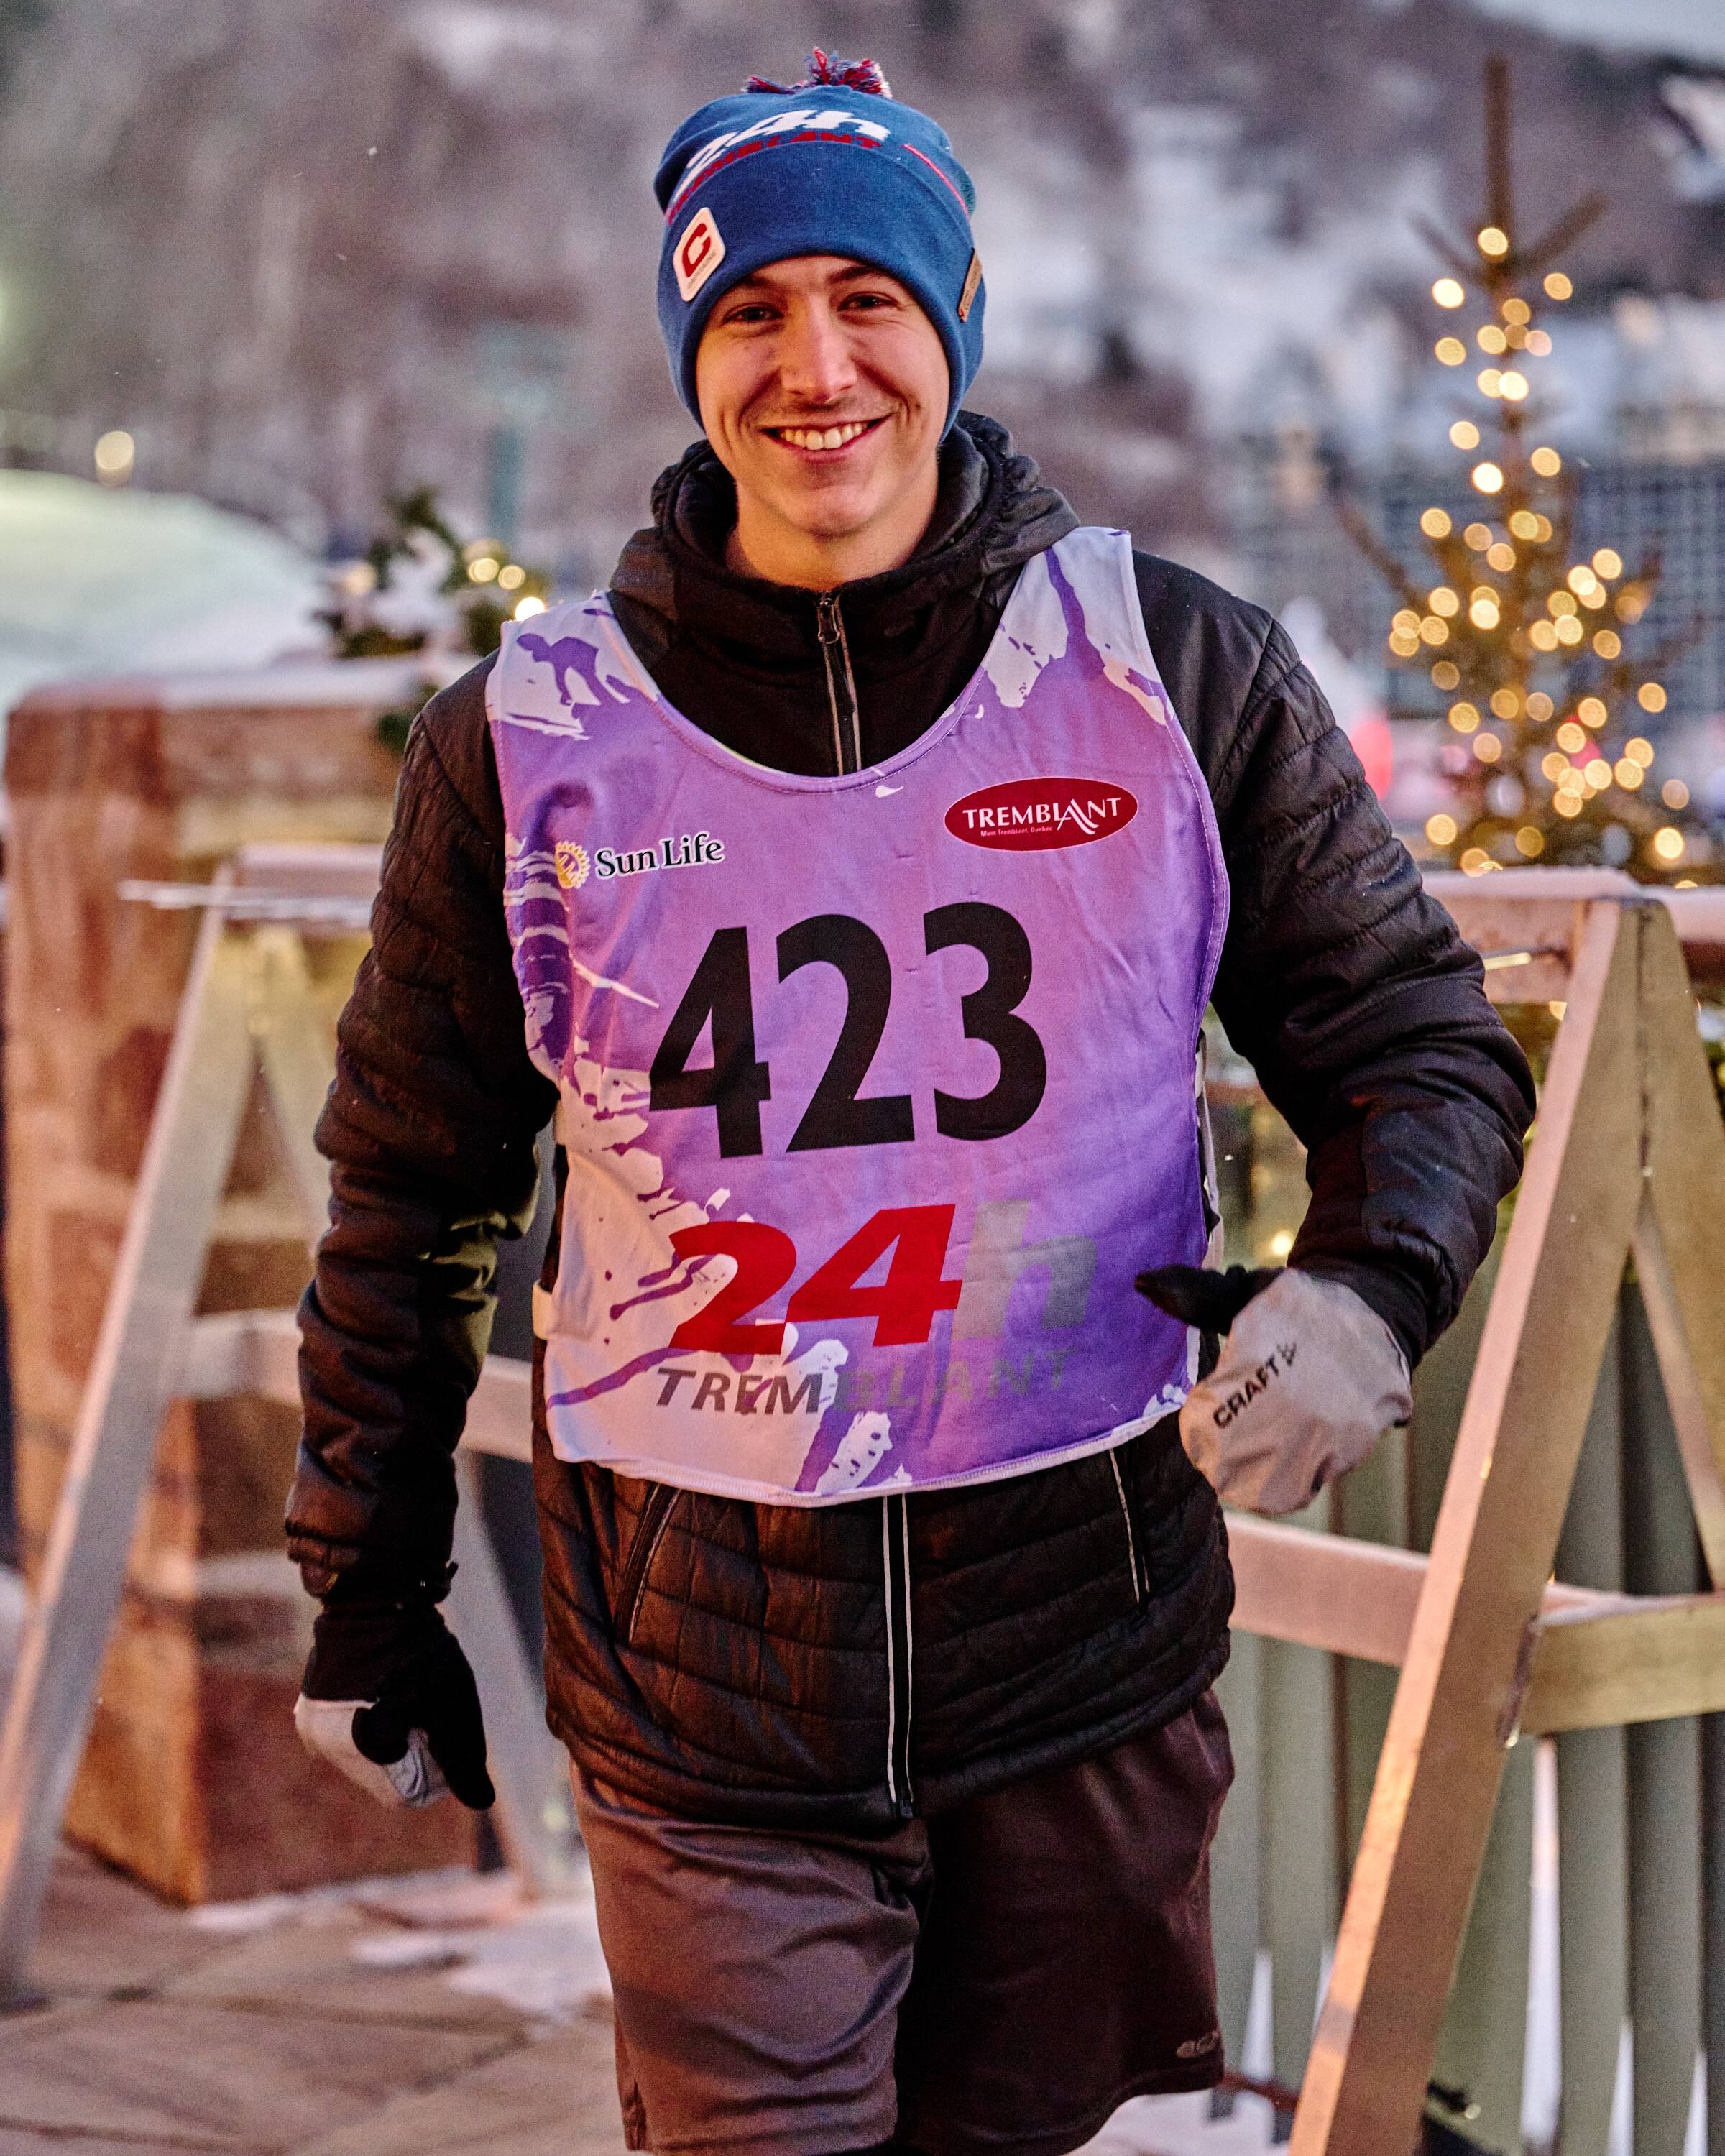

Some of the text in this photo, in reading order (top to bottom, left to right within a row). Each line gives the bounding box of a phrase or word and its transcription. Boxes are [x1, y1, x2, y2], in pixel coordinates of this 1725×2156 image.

[672, 109, 891, 203] 24h
[682, 223, 711, 278] C
[962, 797, 1121, 835] TREMBLANT
[597, 834, 722, 877] Sun Life
[649, 901, 1047, 1158] 423
[656, 1346, 1078, 1415] TREMBLANT
[1213, 1353, 1279, 1429] CRAFT
